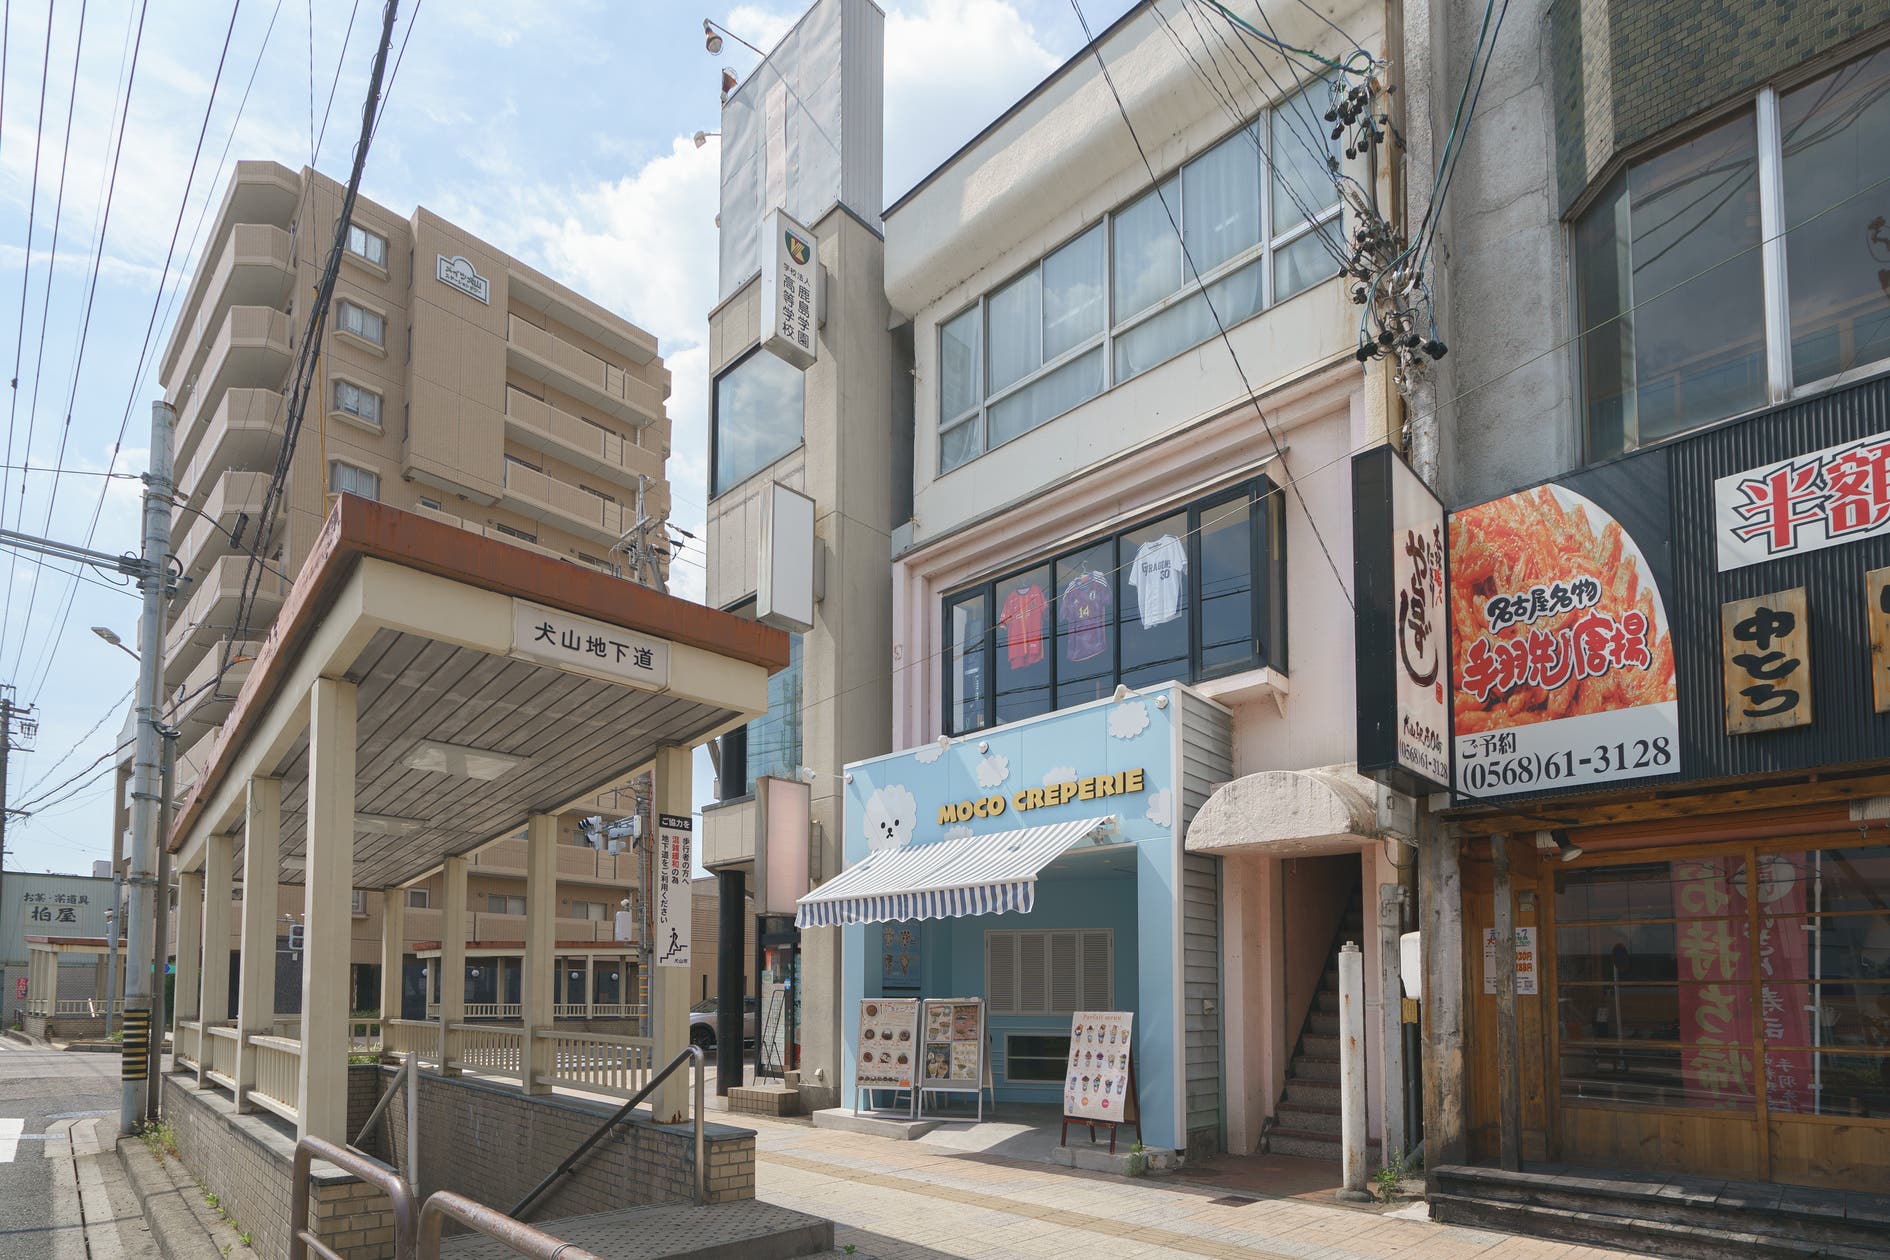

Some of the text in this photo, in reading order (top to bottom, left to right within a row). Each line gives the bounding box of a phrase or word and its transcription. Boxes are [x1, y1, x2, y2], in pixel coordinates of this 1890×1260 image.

[783, 262, 811, 287] 学校法人
[782, 273, 796, 341] 高等学校
[797, 284, 811, 349] 鹿島学園
[1078, 605, 1089, 618] 14
[1486, 577, 1600, 631] 名古屋名物
[534, 622, 653, 670] 犬山地下道
[1462, 610, 1651, 700] 手羽先唐揚
[1732, 606, 1801, 718] 中とろ
[1399, 740, 1448, 779] (0568)61-3128
[1461, 732, 1517, 760] ご予約
[1463, 736, 1672, 793] (0568)61-3128
[936, 768, 1144, 825] MOCO CREPERIE
[661, 817, 691, 829] ご協力を
[660, 834, 669, 924] 地下道をご利用ください
[671, 835, 680, 885] 混雑緩和の為
[681, 837, 690, 885] 歩行者の方へ
[31, 906, 77, 923] 柏屋
